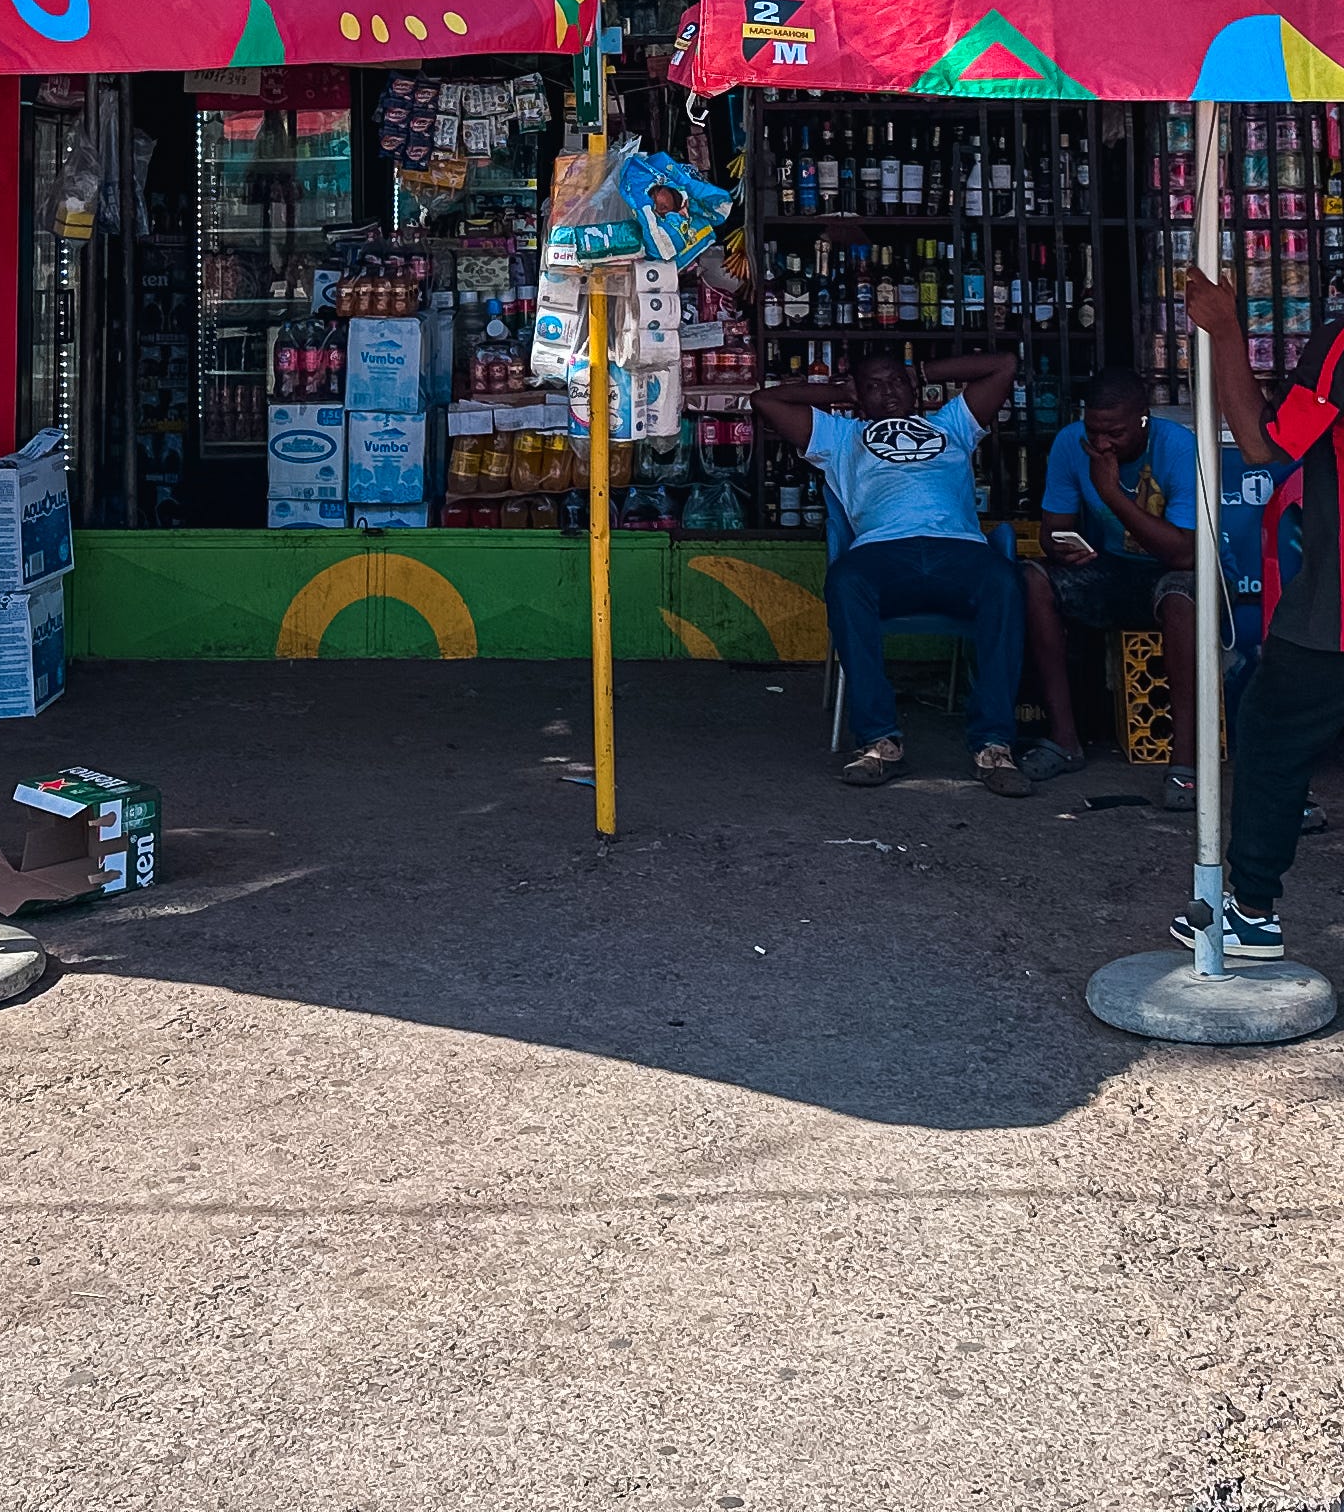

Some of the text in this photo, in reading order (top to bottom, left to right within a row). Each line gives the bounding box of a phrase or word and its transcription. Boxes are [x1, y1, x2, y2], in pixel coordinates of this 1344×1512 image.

[753, 0, 780, 24] 2
[681, 24, 696, 40] 2
[773, 41, 809, 65] M
[361, 350, 405, 366] Vumba
[364, 439, 408, 454] Vumba
